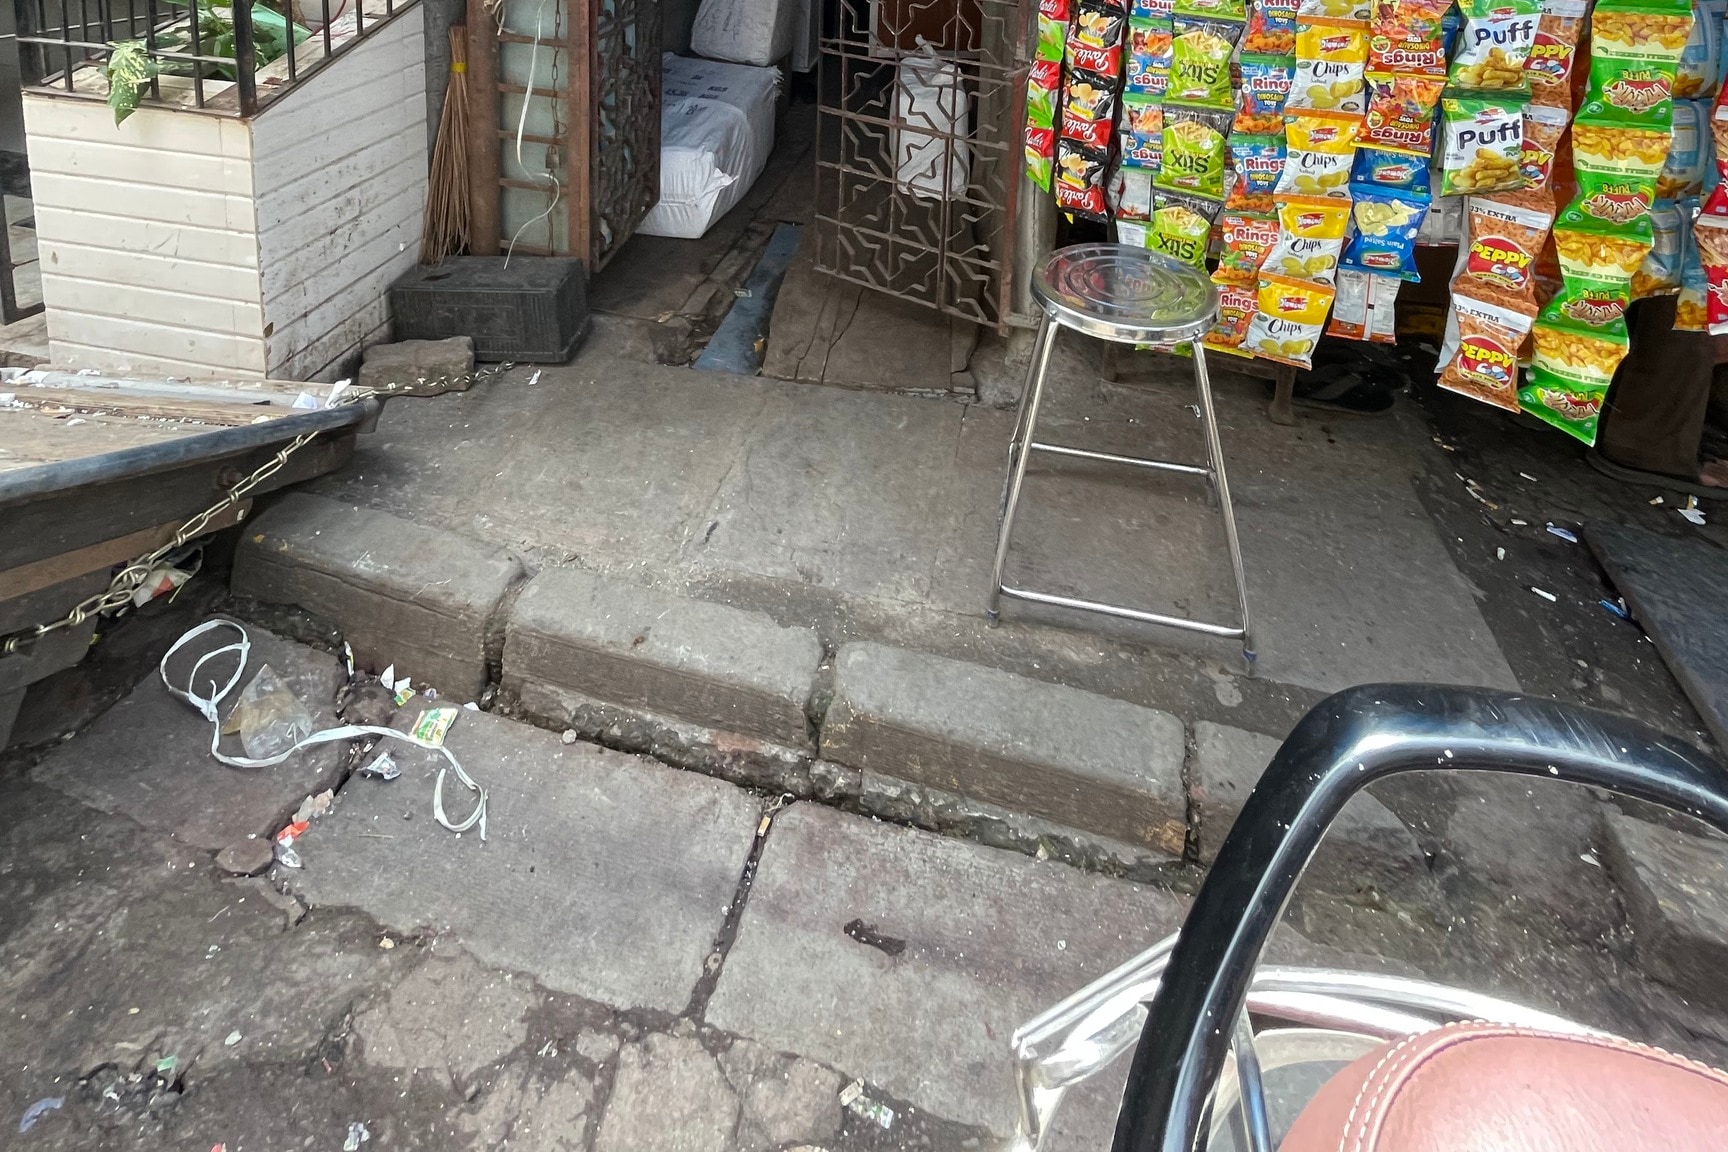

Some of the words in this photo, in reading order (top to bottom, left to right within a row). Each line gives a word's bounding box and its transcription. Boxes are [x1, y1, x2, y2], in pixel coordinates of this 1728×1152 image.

[1474, 20, 1533, 46] Puff
[1383, 49, 1436, 66] Rings
[1531, 44, 1574, 59] PPY
[1178, 60, 1219, 85] Stix
[1312, 61, 1349, 77] Chips
[1623, 69, 1651, 81] PUFFS
[1134, 73, 1168, 88] ings
[1372, 128, 1422, 143] Rings
[1458, 119, 1521, 150] Puff
[1171, 150, 1210, 174] Stix
[1301, 152, 1338, 168] Chips
[1602, 182, 1630, 194] PUFFS
[1487, 209, 1518, 222] EXTRA
[1235, 228, 1279, 245] Rings
[1364, 237, 1386, 247] Salted
[1158, 232, 1197, 259] Stix
[1290, 239, 1322, 253] Chips
[1386, 241, 1405, 249] Plain
[1471, 242, 1533, 268] PEPPY
[1470, 309, 1500, 323] EXTRA
[1268, 319, 1302, 335] Chips
[1461, 340, 1516, 368] PEPPY
